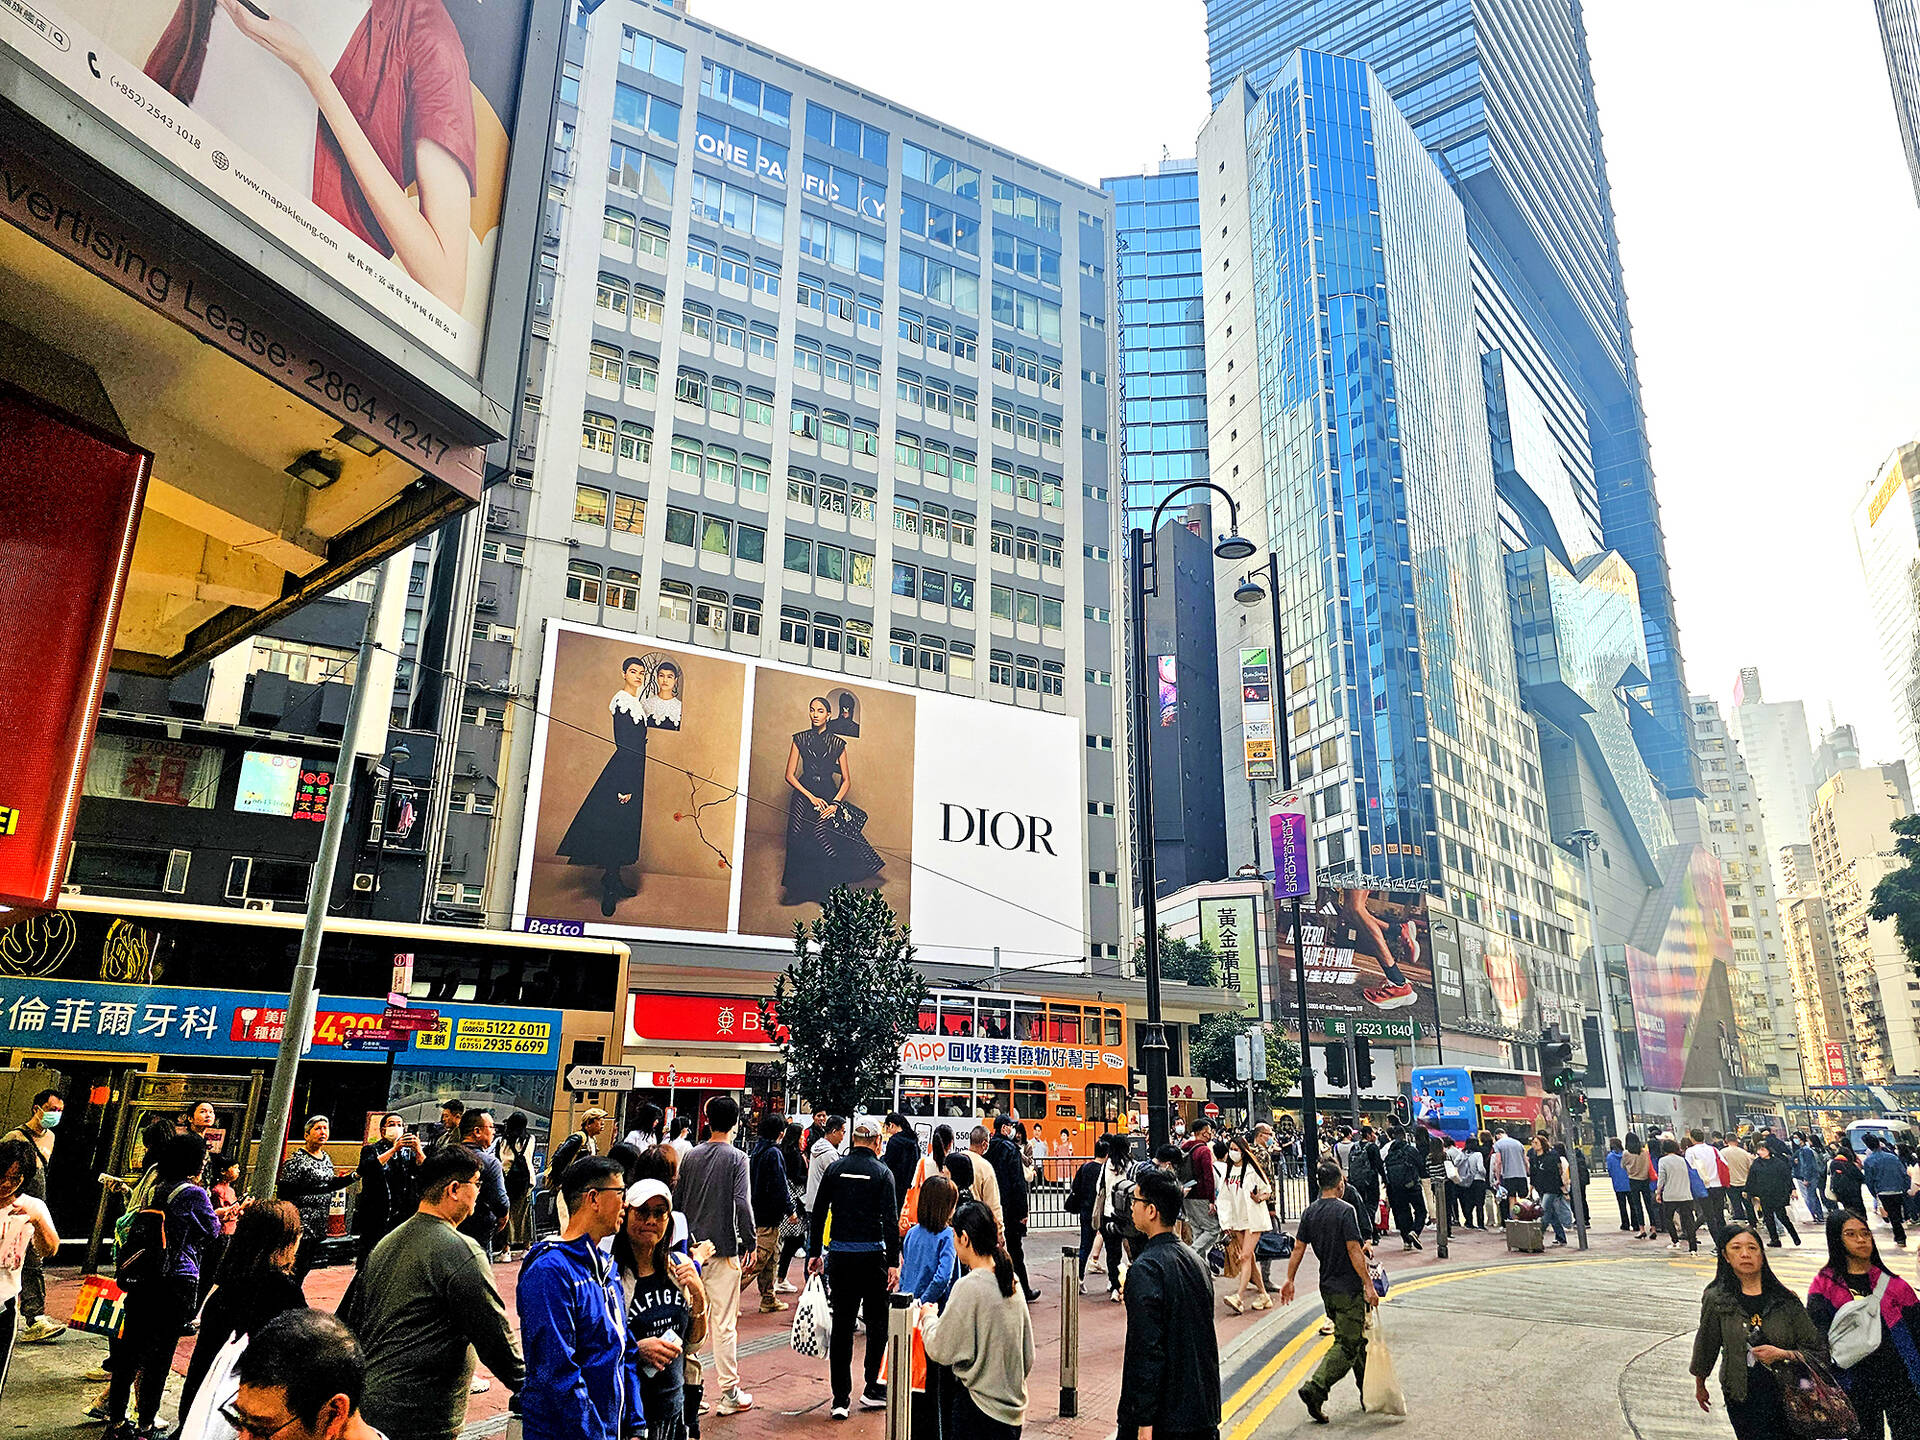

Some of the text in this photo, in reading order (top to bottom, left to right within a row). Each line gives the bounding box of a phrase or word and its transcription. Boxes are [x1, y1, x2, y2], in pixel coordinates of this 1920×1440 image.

[110, 74, 202, 150] (+852) 2543 1018
[699, 134, 749, 167] ONE
[234, 169, 339, 250] www.mapakleung.com
[183, 280, 297, 375] Lease:
[304, 358, 377, 424] 2864
[384, 413, 450, 465] 4247
[121, 757, 189, 806] 租
[938, 802, 1058, 857] DIOR
[1285, 817, 1298, 893] HONG KONG
[528, 919, 580, 936] Bestco
[1217, 907, 1241, 993] 黃金廣場
[0, 995, 218, 1040] 倫菲爾牙科
[486, 1021, 516, 1035] 5122
[518, 1023, 546, 1037] 6011
[1334, 1022, 1346, 1034] 租
[1355, 1022, 1411, 1037] 2523 1840
[420, 1034, 446, 1046] 連鎖
[459, 1038, 544, 1053] (0755) 2935 6699
[948, 1042, 1100, 1070] 回收建築廢物好幫手
[589, 1077, 619, 1087] 怡和街
[962, 1066, 992, 1075] Recycling
[992, 1067, 1032, 1076] Construction
[627, 1289, 690, 1325] ILFIGE
